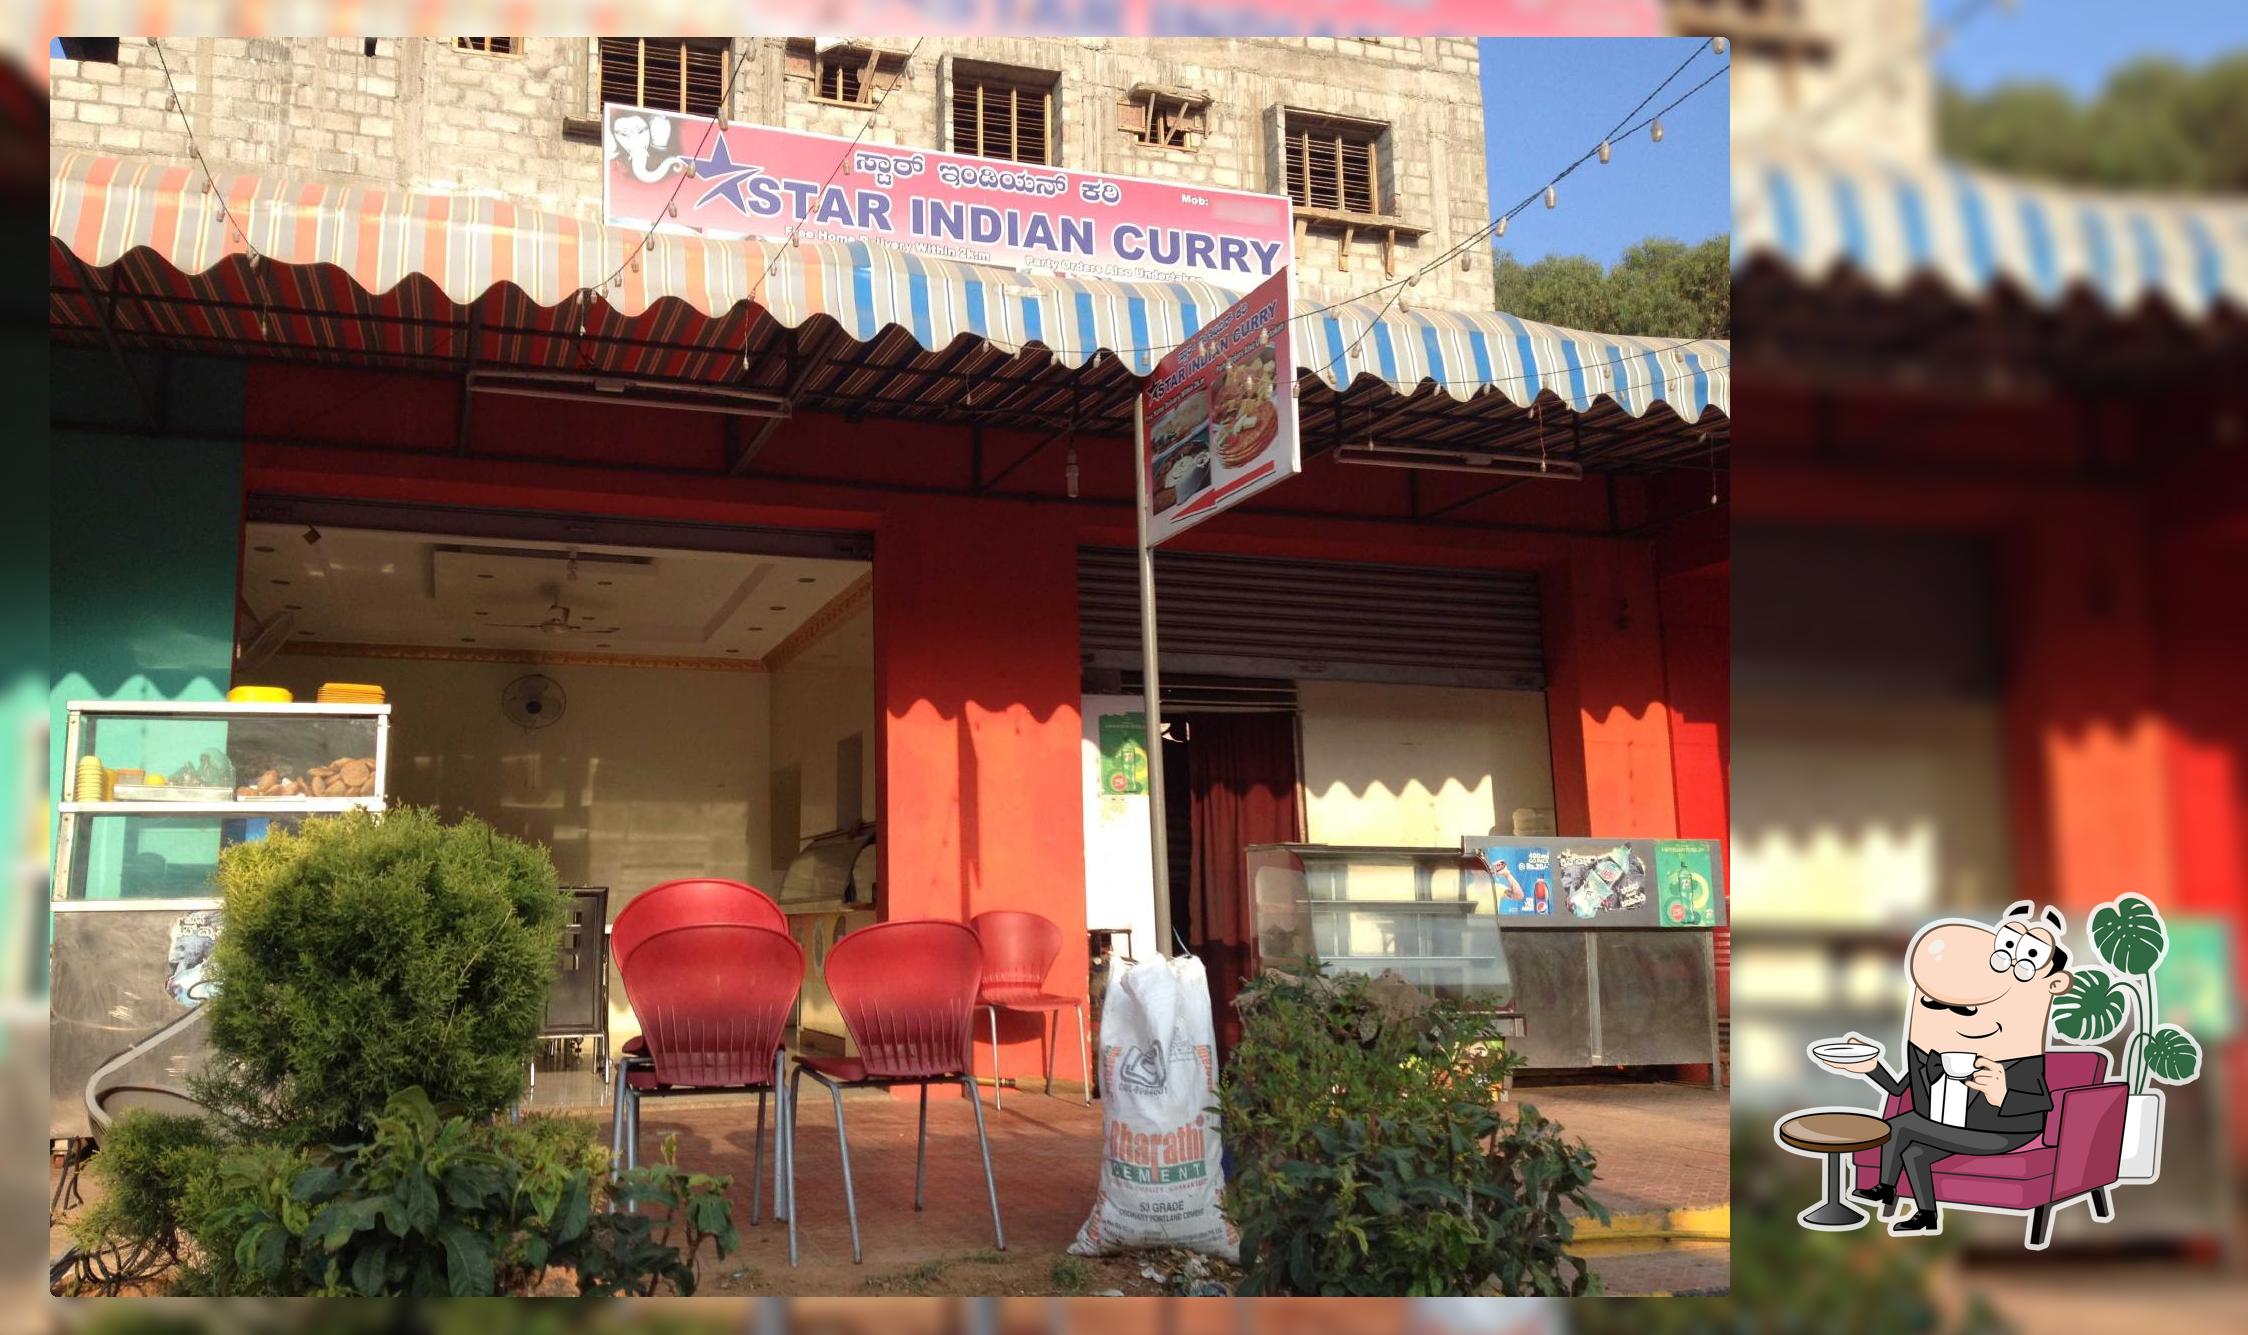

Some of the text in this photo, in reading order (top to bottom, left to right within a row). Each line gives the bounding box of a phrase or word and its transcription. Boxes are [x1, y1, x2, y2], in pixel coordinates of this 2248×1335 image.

[856, 153, 1121, 204] ಸ್ಟಾರ್ ಇಂಡಿಯನ್ ಕರಿ
[1181, 194, 1209, 206] Mob:
[749, 177, 1281, 276] STAR INDIAN CURRY
[818, 230, 855, 244] Home
[860, 234, 912, 253] Dlivery
[915, 242, 956, 258] Within
[1025, 255, 1059, 271] Party
[1060, 260, 1103, 274] Orders
[1104, 264, 1132, 277] Also
[1156, 366, 1187, 398] STAR
[1232, 300, 1277, 343] CURRY
[1112, 1162, 1201, 1183] CEMENT
[1152, 1200, 1185, 1212] GRADE
